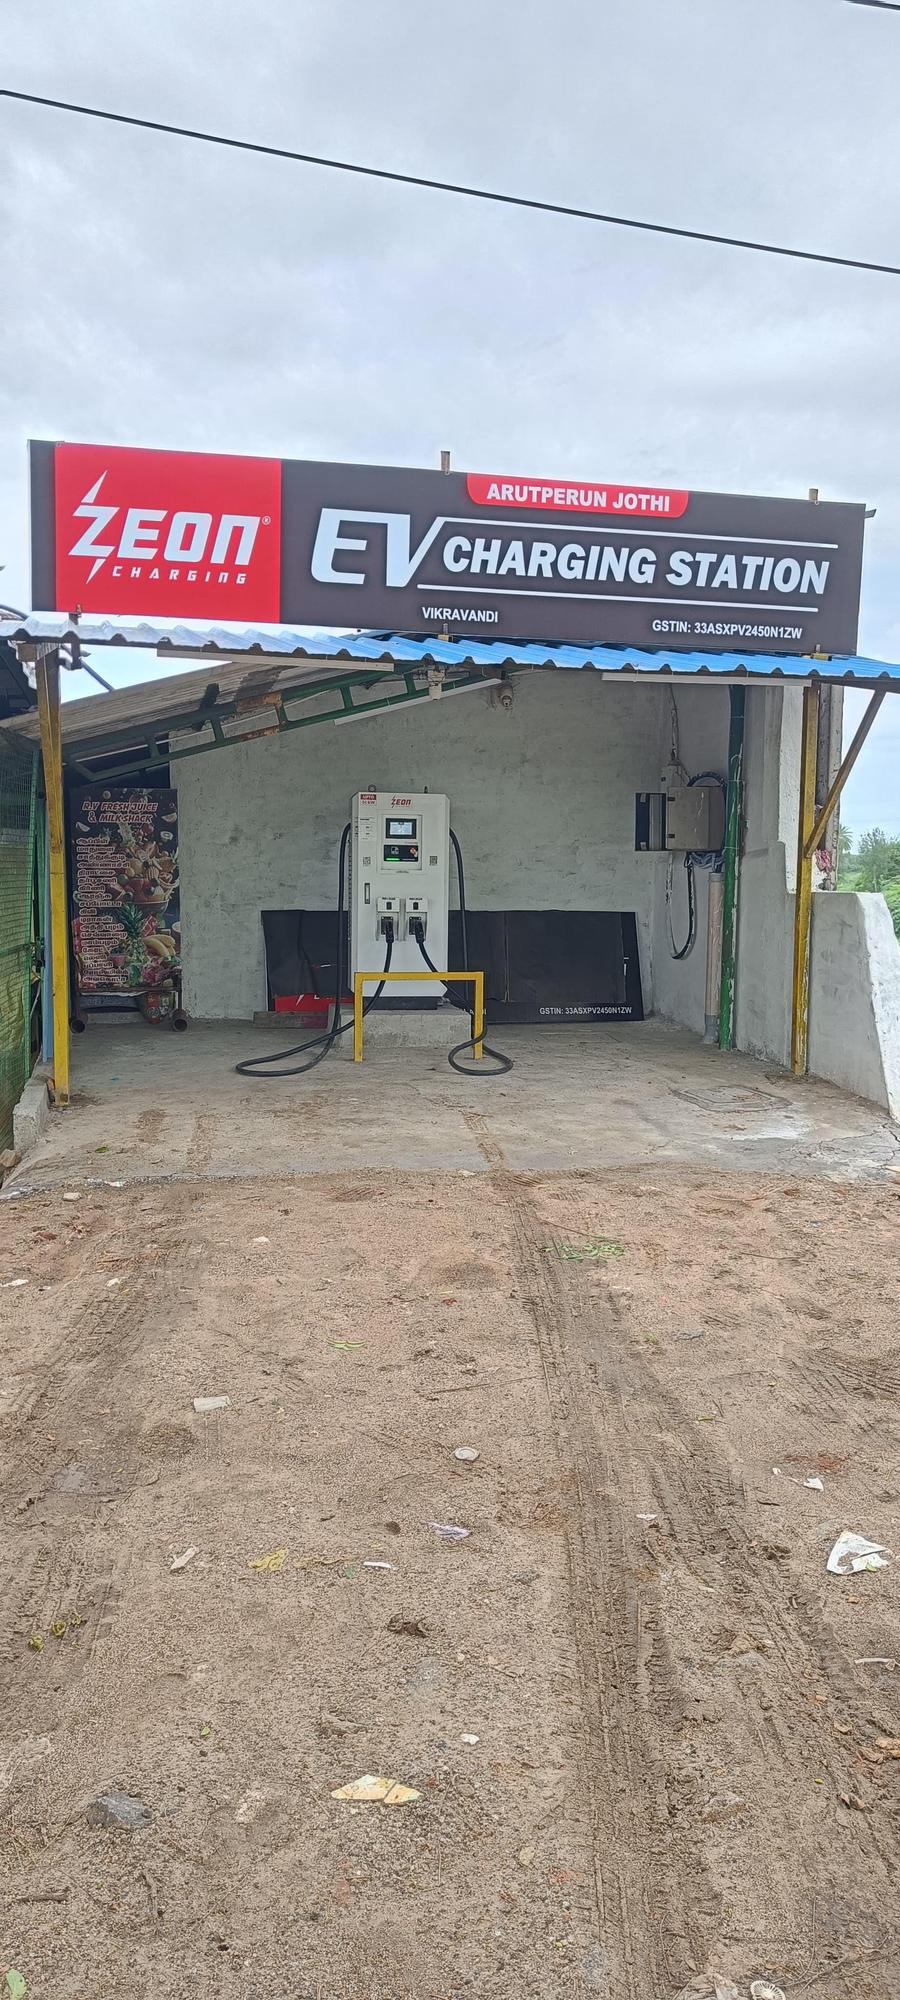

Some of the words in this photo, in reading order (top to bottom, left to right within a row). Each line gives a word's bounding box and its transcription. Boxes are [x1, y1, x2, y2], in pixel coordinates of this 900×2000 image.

[486, 483, 607, 507] ARUTPERUN
[612, 491, 670, 512] JOTHI
[68, 470, 261, 566] ZEON
[311, 507, 443, 588] EV
[442, 535, 657, 585] CHARGING
[665, 551, 830, 595] STATION
[112, 565, 247, 585] CHARGING
[422, 606, 498, 623] VIKRAVANDI
[652, 619, 691, 634] GSTIN:
[694, 621, 803, 640] 33ASXPV2450N1ZW
[101, 802, 129, 811] FRESH
[130, 803, 158, 812] JUICE
[391, 796, 412, 806] ZEON
[88, 811, 97, 823] &
[99, 814, 121, 822] MILK
[539, 1007, 564, 1015] GSTIN:
[565, 1006, 632, 1014] 33ASXPV2450N1ZW
